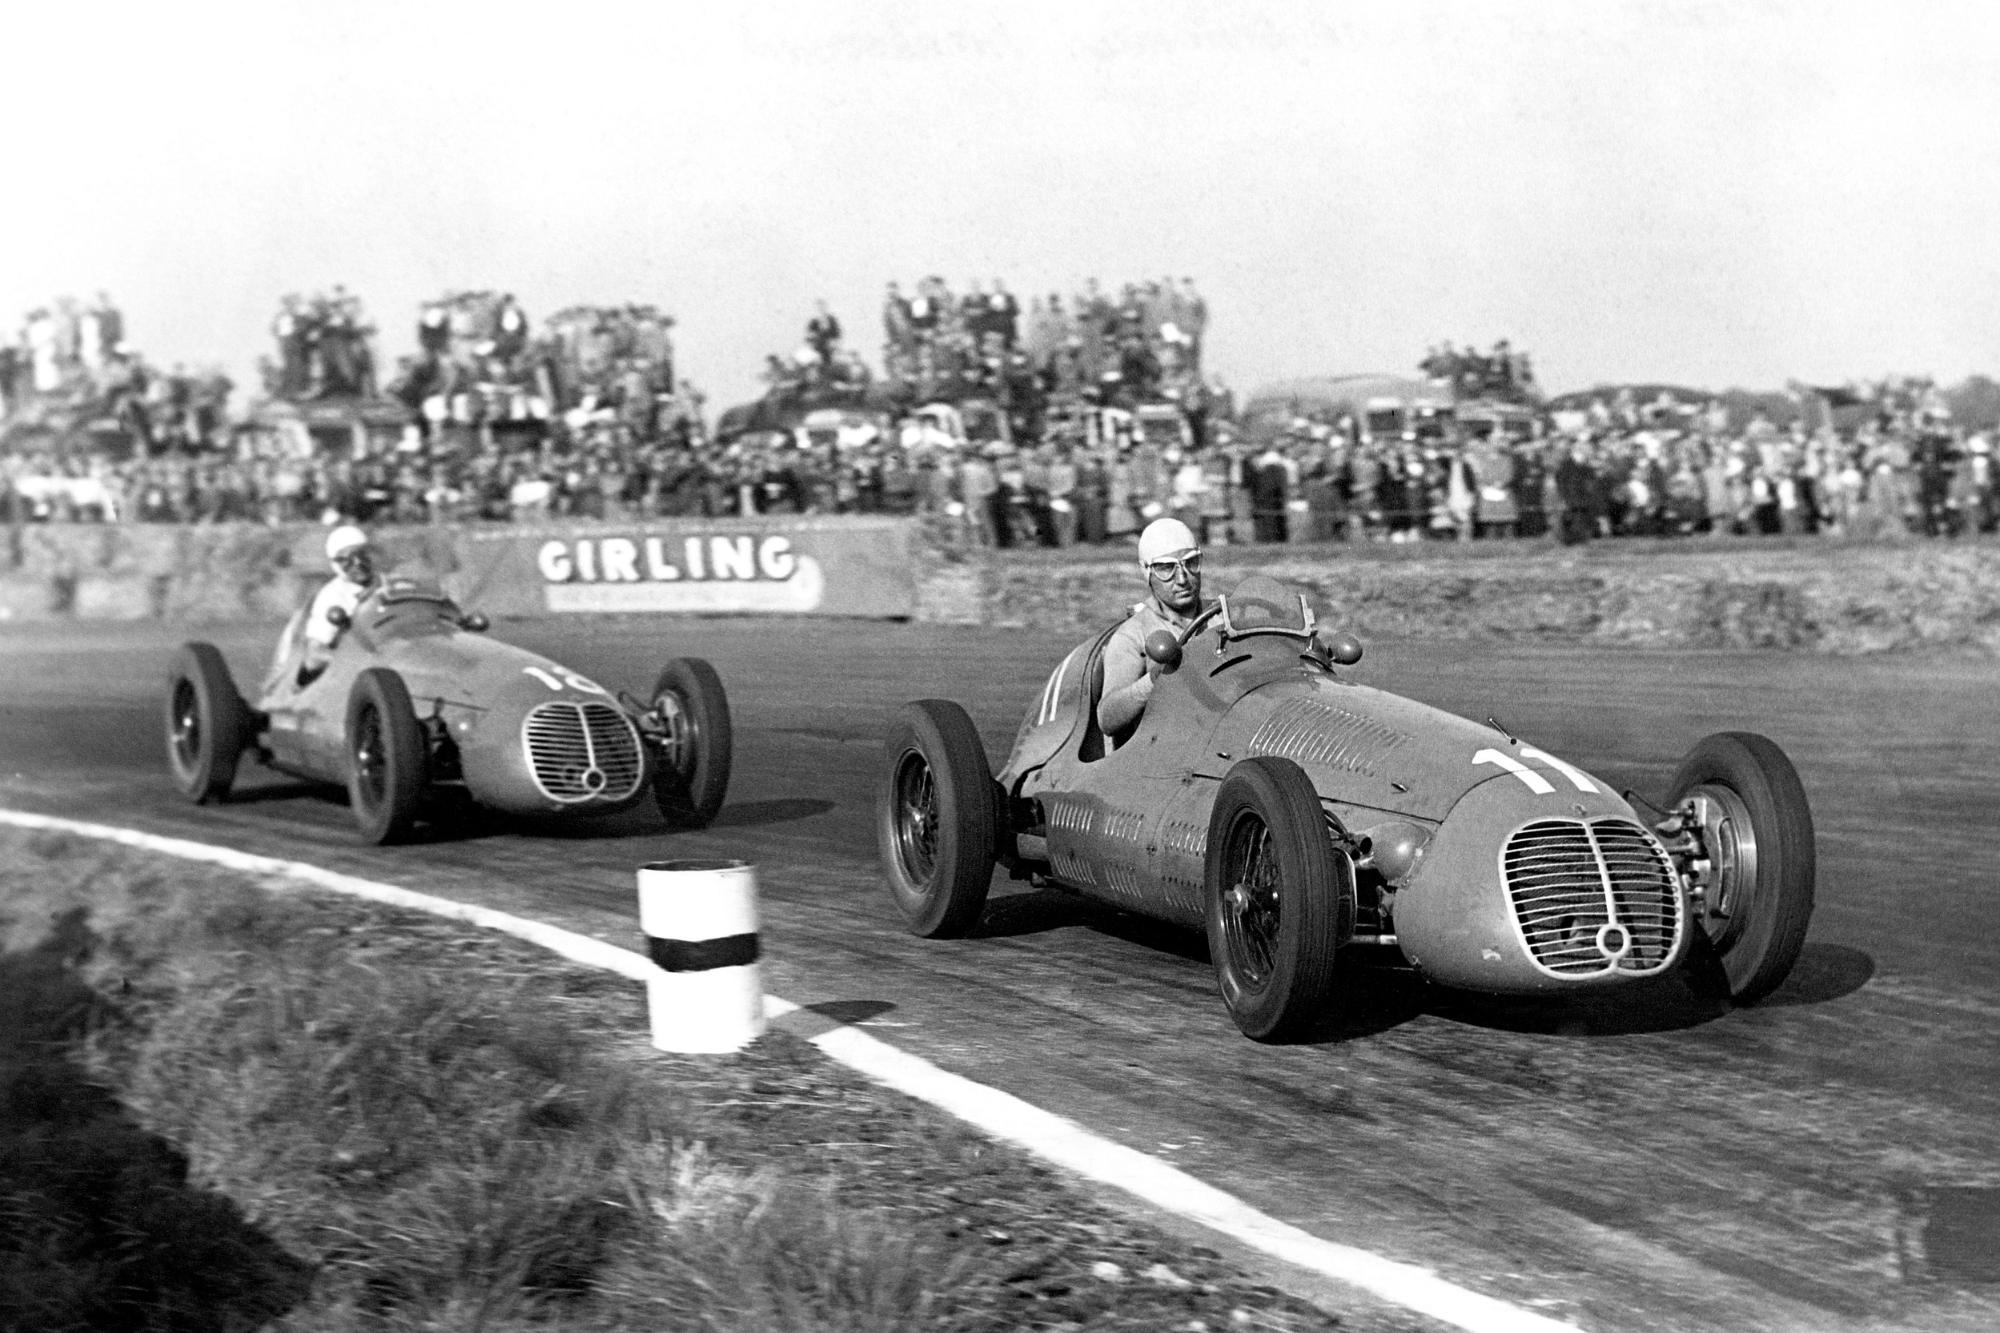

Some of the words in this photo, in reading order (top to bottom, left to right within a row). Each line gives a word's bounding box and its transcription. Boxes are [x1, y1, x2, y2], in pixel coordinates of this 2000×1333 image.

[538, 536, 794, 581] GIRLING
[1038, 648, 1077, 725] 11
[1471, 748, 1600, 794] 11
